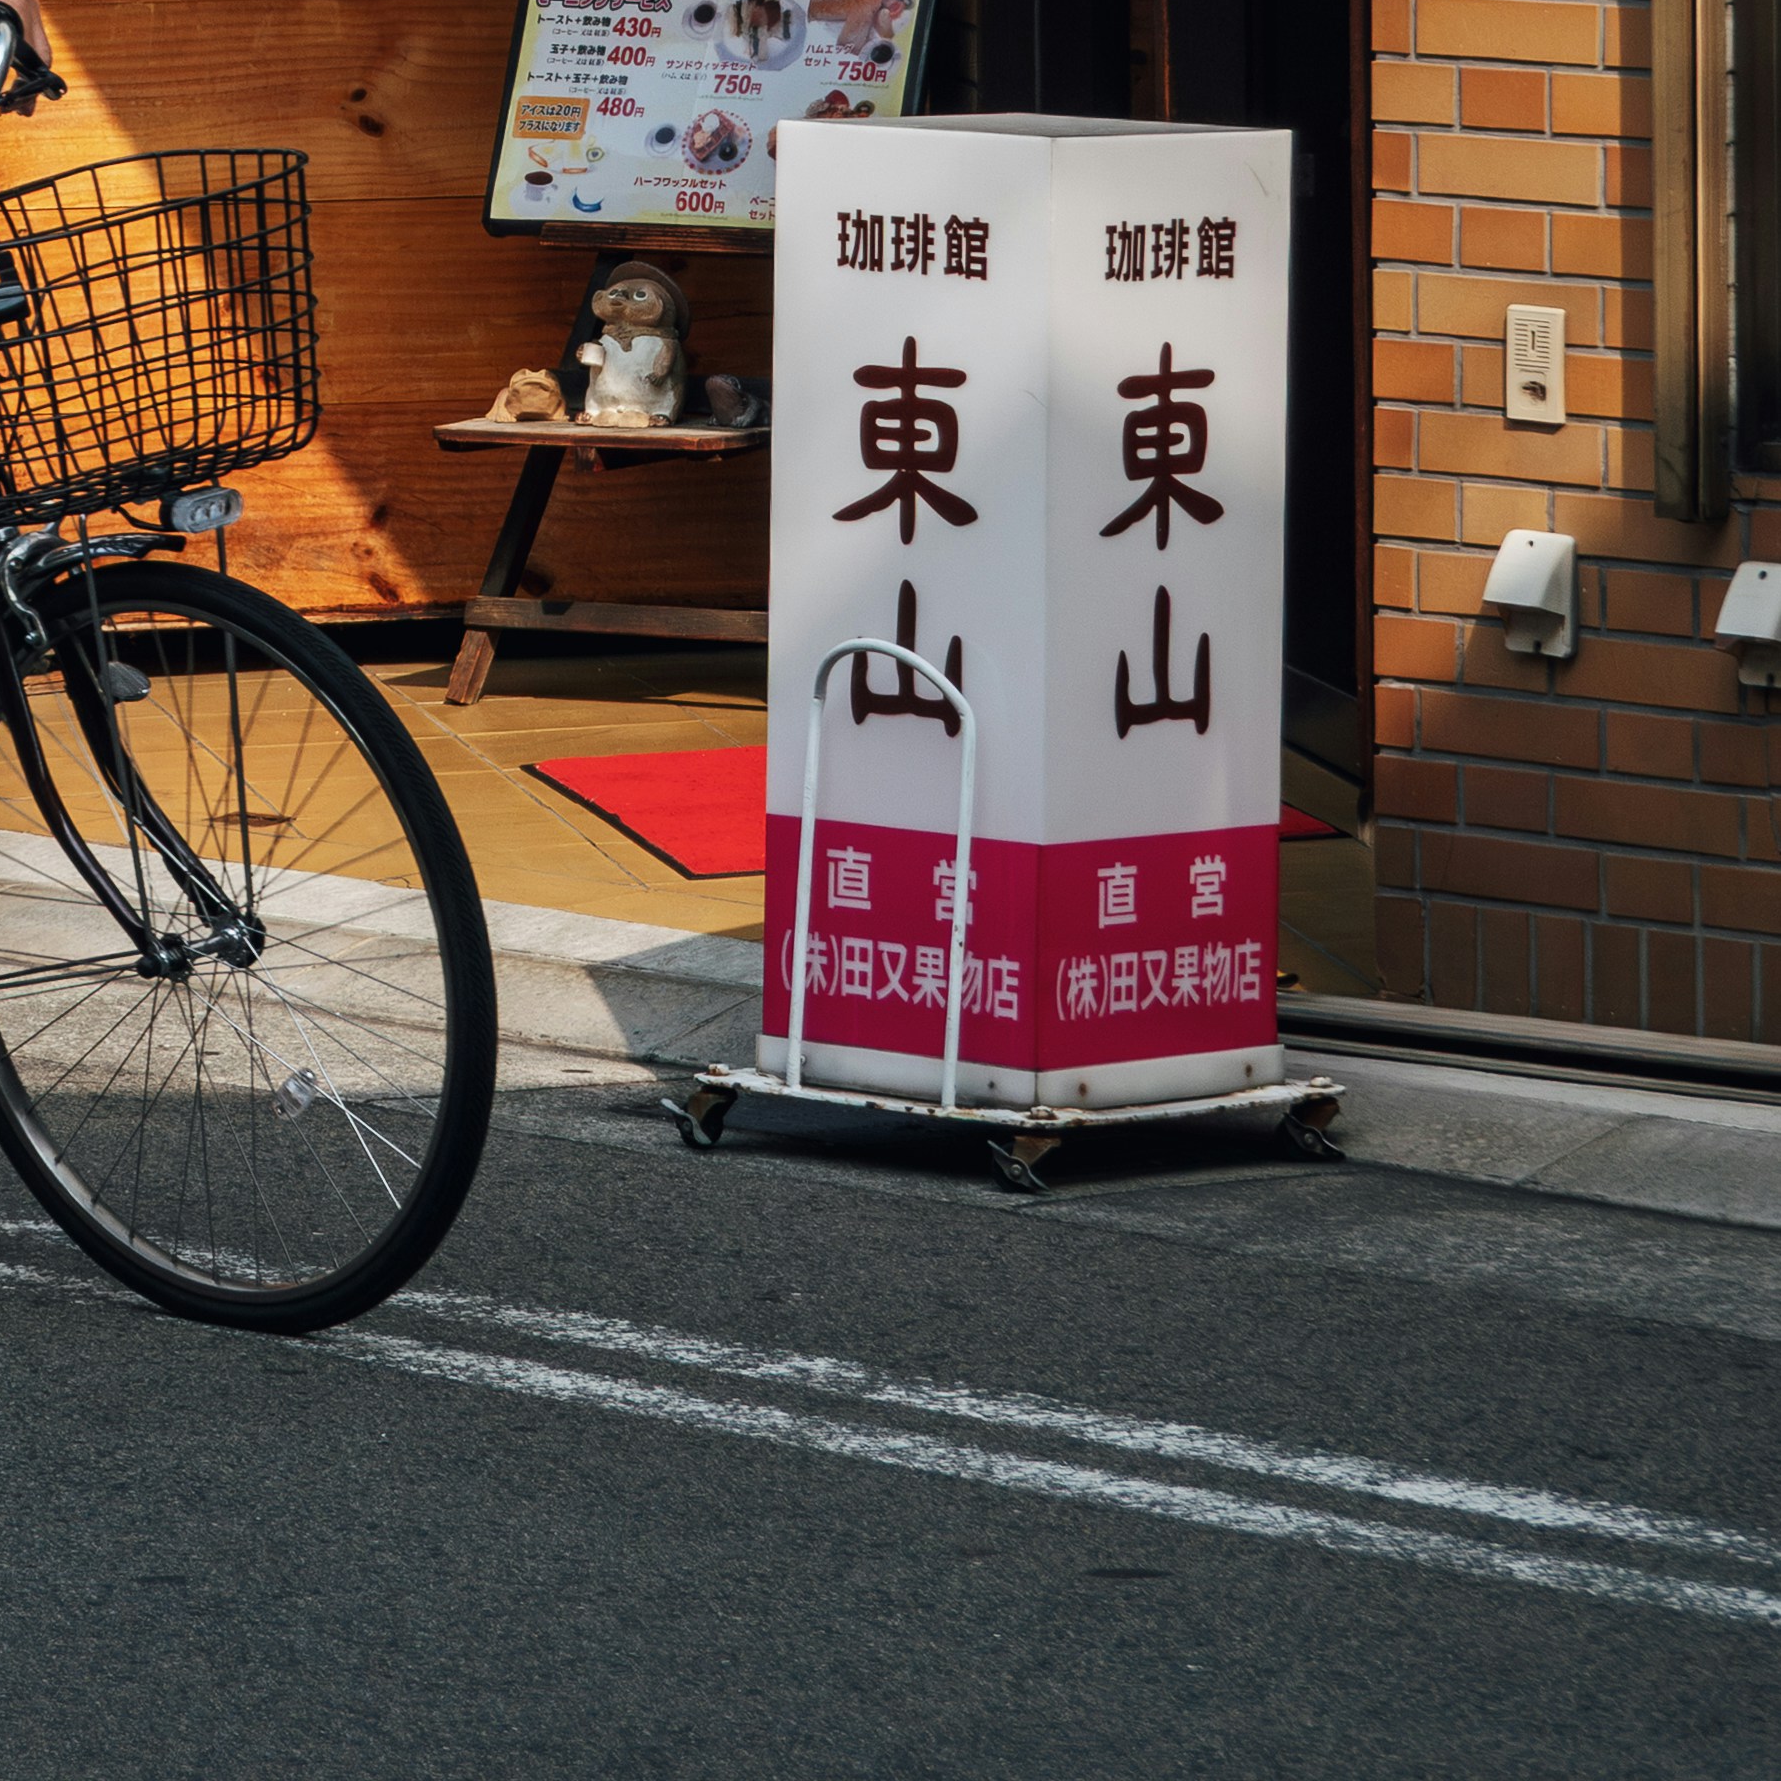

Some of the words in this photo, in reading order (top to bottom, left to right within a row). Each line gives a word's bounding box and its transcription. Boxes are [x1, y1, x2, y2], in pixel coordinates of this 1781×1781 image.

[612, 16, 662, 38] 430円
[606, 45, 656, 67] 400円
[665, 59, 757, 72] サンドウィッチセット
[804, 57, 832, 68] セット
[837, 60, 887, 83] 750円
[713, 74, 762, 95] 750円
[521, 104, 582, 118] アイスは20円
[596, 97, 645, 118] 480円
[518, 120, 581, 133] プラスになります
[633, 176, 727, 190] ハーフワッフルセット
[675, 190, 725, 214] 600円
[836, 209, 990, 282] 珈琲館
[1104, 216, 1237, 283] 珈琲館
[832, 335, 979, 737] 東山
[1098, 341, 1225, 740] 東山
[826, 845, 977, 925] 直営
[1097, 854, 1227, 929] 直営
[1056, 938, 1262, 1022] (株)田又果物店
